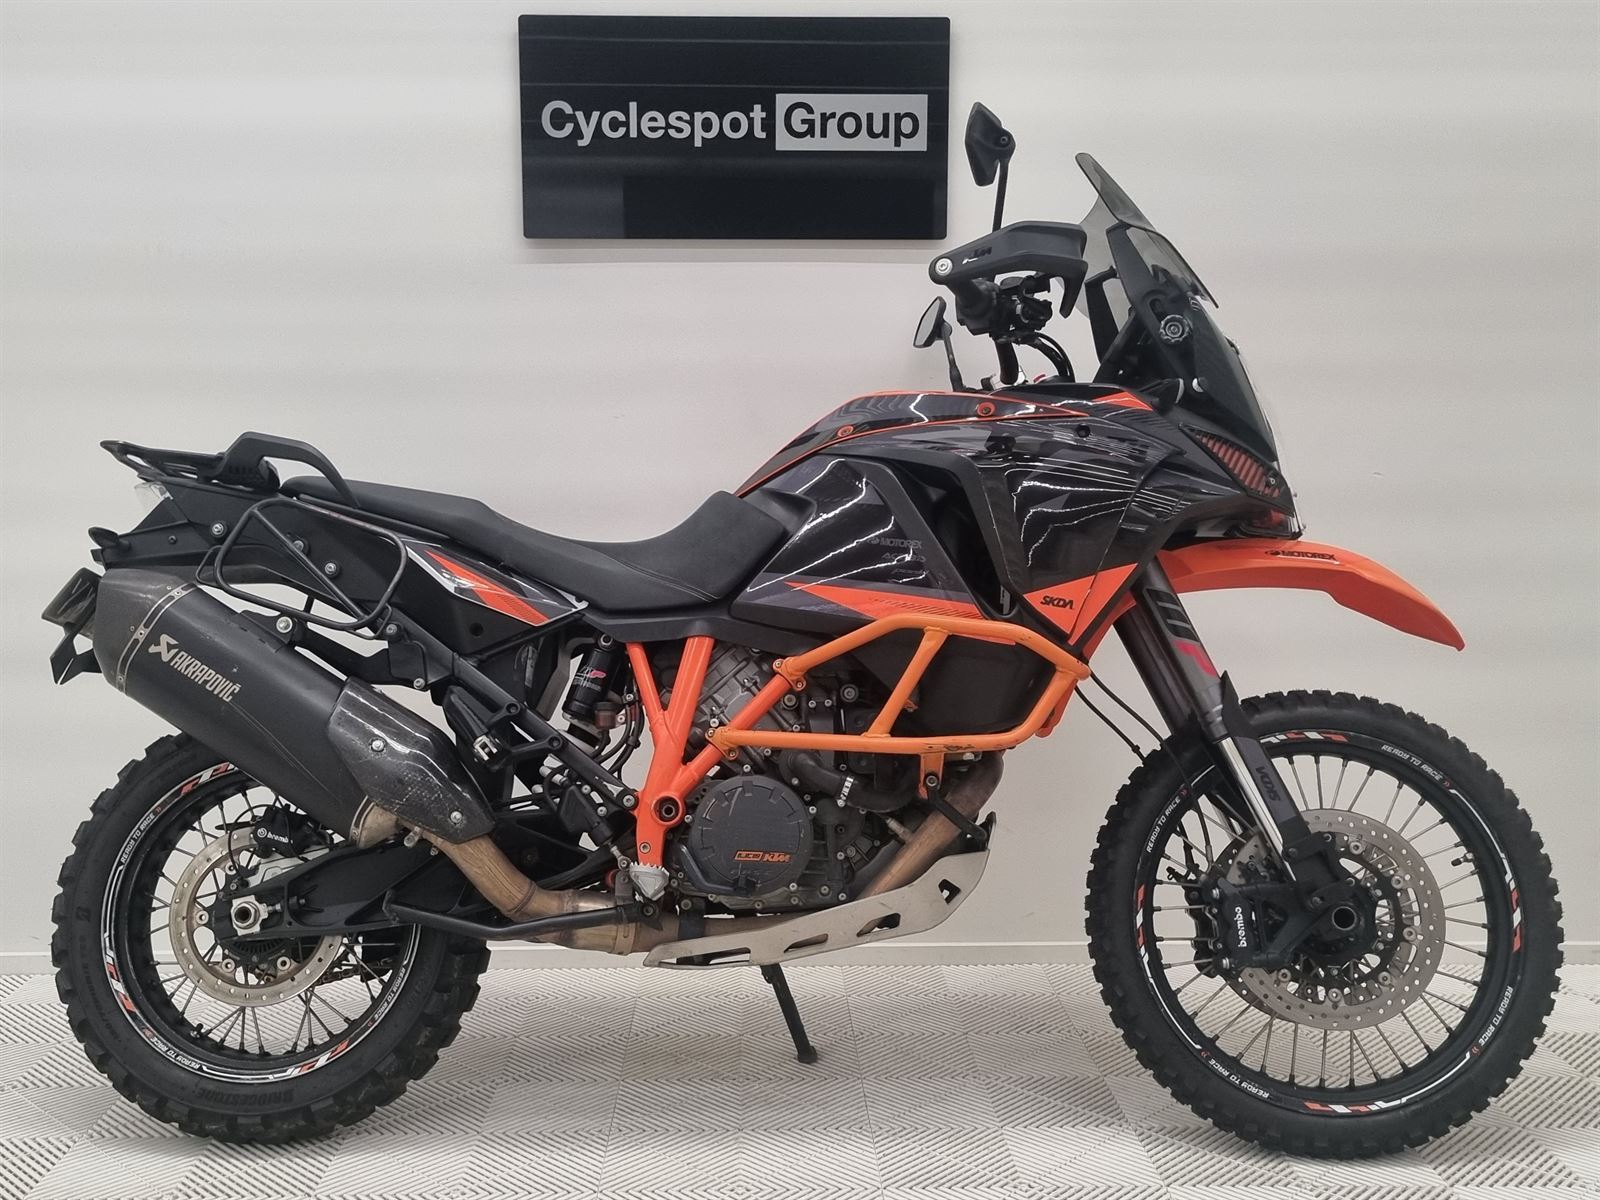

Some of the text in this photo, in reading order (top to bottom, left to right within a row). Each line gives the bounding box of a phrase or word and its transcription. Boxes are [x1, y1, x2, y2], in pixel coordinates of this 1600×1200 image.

[541, 100, 920, 147] Cyclespot Group
[1280, 550, 1337, 561] MOTOREX
[1040, 595, 1073, 609] SKDA
[1381, 744, 1443, 781] READY TO RACE
[120, 838, 135, 864] READY
[139, 812, 155, 831] RACE
[1146, 795, 1180, 853] READY TO RACE
[763, 852, 790, 862] KTM
[1234, 906, 1247, 947] brembo
[392, 967, 406, 993] READY
[374, 1001, 389, 1020] RACE
[1478, 985, 1514, 1047] READY TO RACE
[150, 1036, 168, 1052] RACE
[175, 1055, 201, 1070] READY
[1208, 1058, 1270, 1099] READY TO RACE
